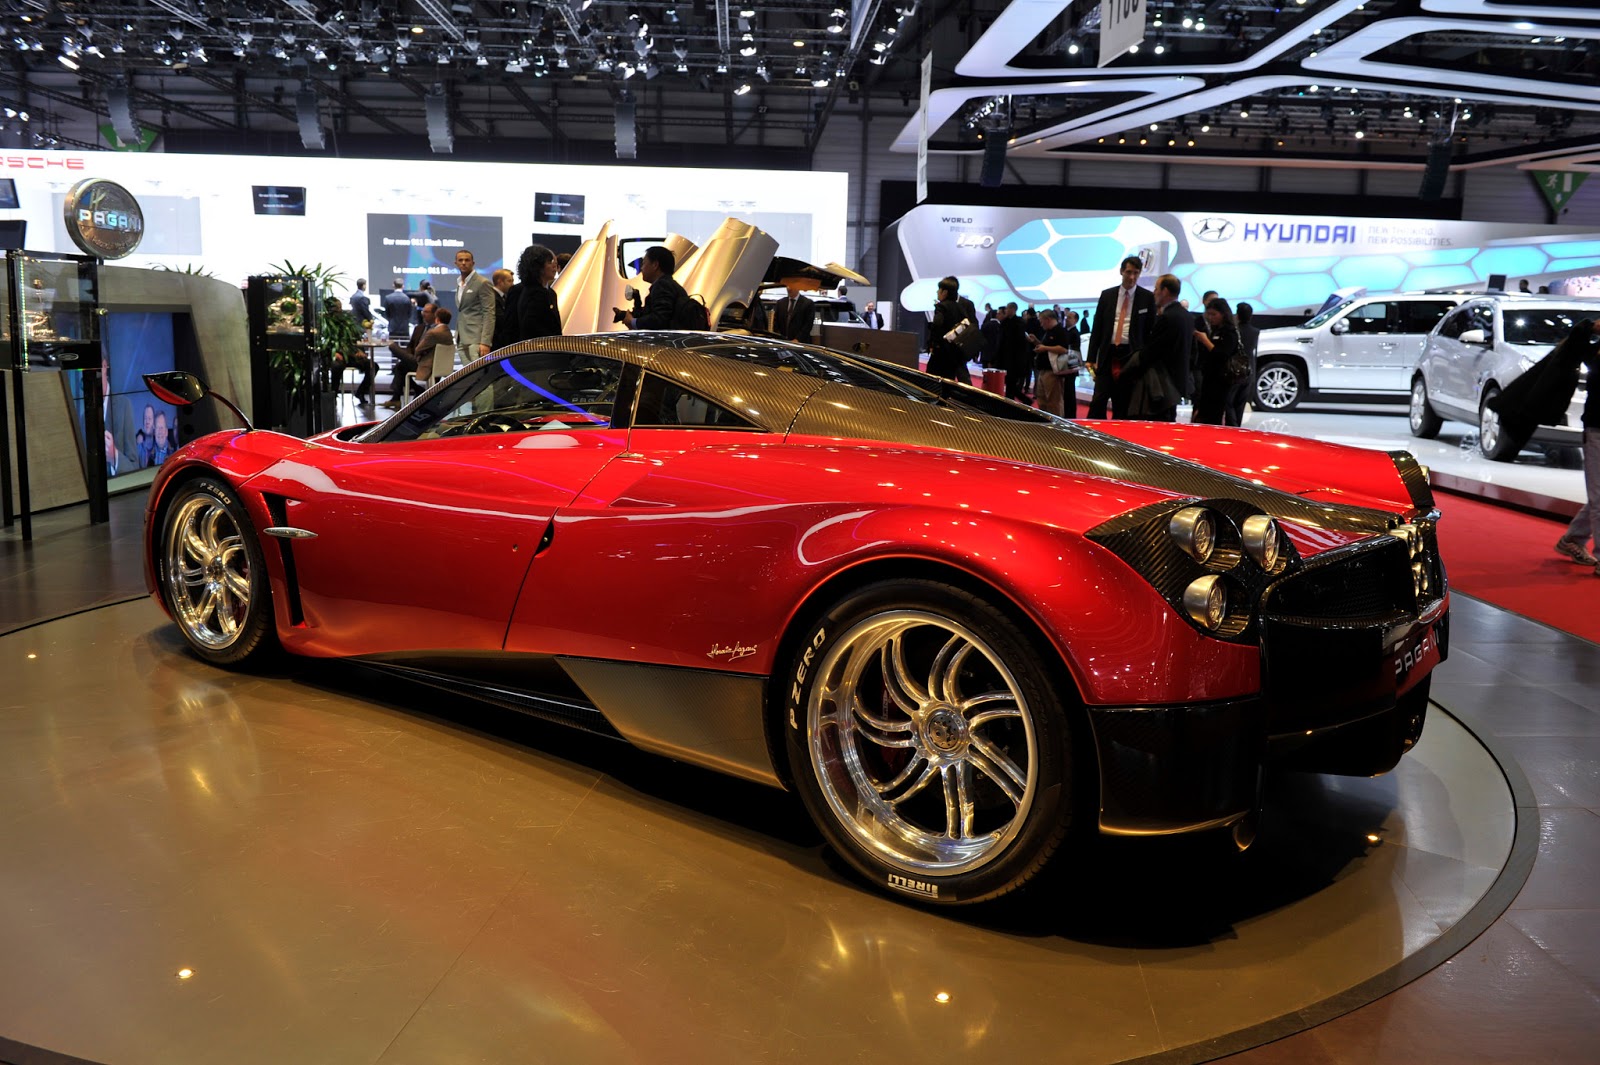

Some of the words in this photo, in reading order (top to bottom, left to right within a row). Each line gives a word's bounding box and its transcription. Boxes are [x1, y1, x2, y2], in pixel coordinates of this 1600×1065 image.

[0, 157, 84, 170] SCHE
[78, 209, 142, 232] PAGANI
[941, 216, 973, 224] WORLD
[1243, 222, 1356, 244] HYUNDAI
[207, 484, 231, 505] ZERO
[1394, 628, 1440, 675] PAGANI
[791, 627, 826, 705] ZERO
[790, 708, 798, 730] P
[887, 873, 939, 898] PIRELLI
